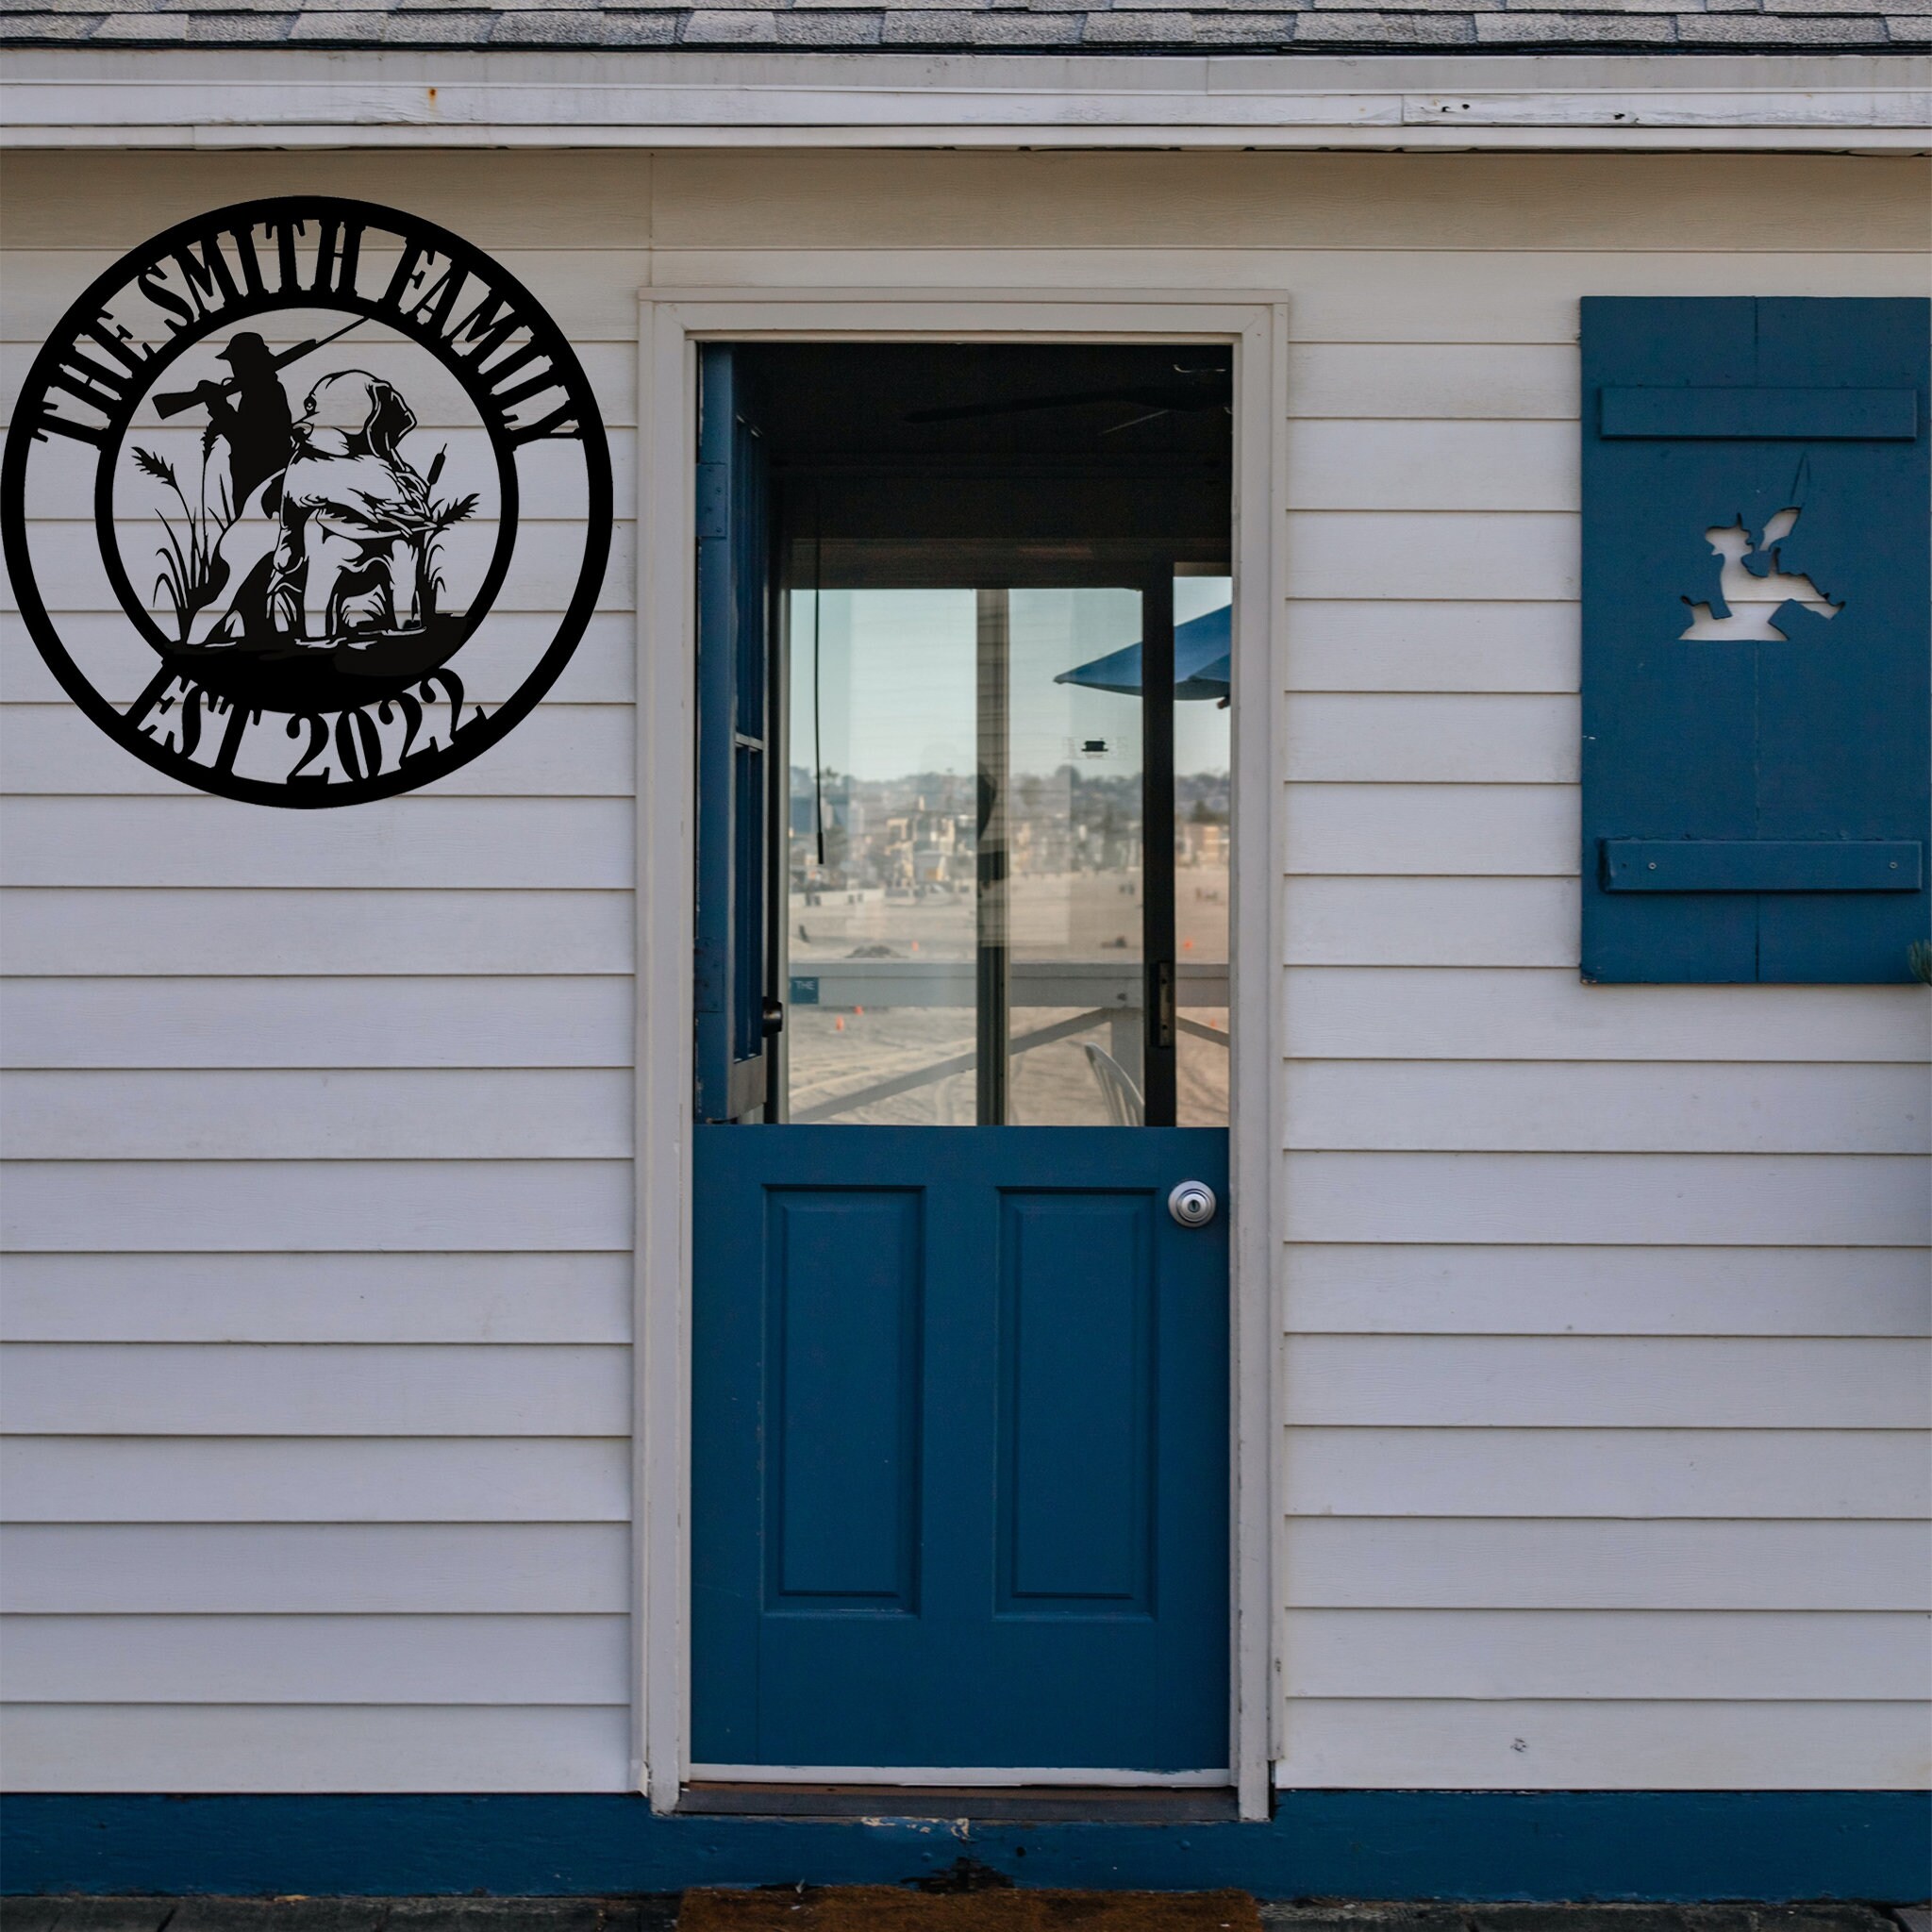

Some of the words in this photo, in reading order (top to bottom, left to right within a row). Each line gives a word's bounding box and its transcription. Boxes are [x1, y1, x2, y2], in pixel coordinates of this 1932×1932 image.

[30, 308, 158, 452] THE
[138, 219, 366, 332] SMITH
[379, 236, 583, 451] FAMILY
[124, 658, 262, 775] EST
[286, 668, 489, 785] 2022
